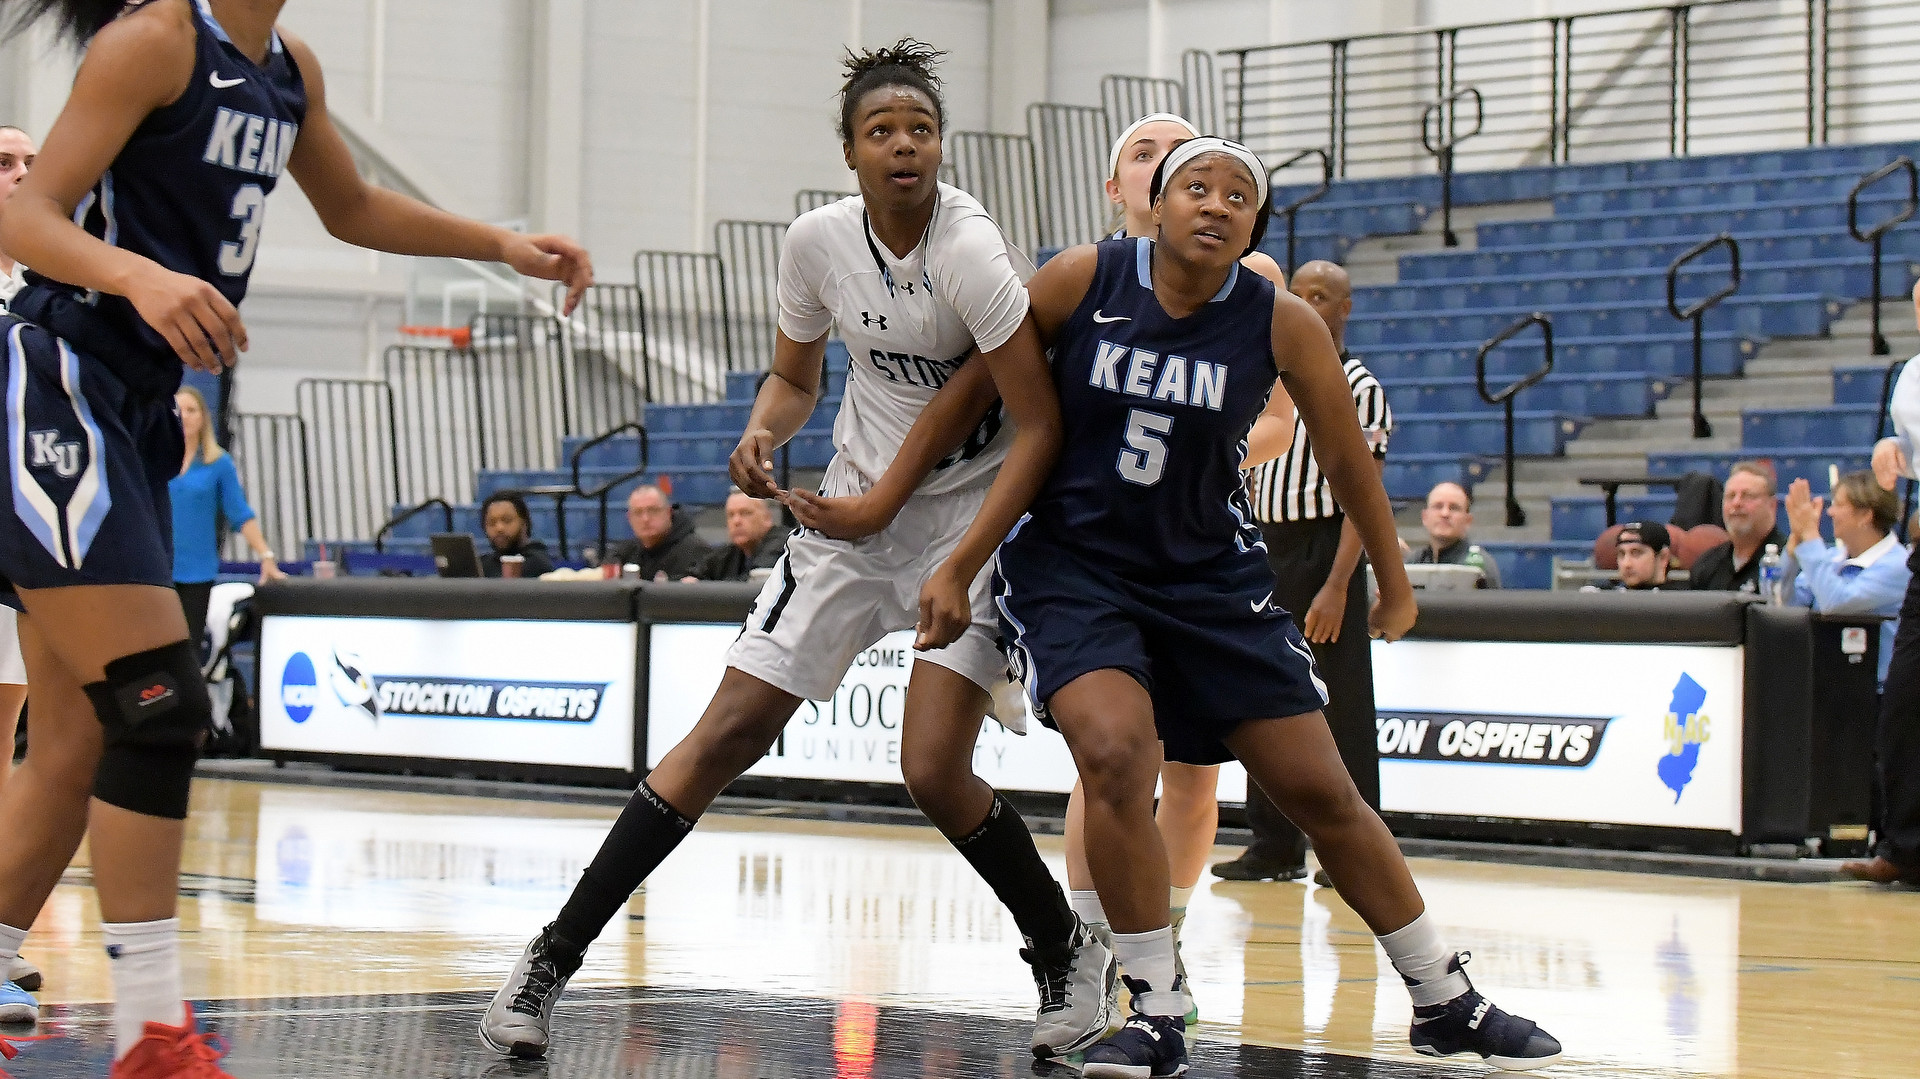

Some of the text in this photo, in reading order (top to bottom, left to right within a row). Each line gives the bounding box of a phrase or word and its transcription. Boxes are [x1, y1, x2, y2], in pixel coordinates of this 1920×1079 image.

[217, 183, 265, 277] 3
[1089, 340, 1228, 411] KEAN
[28, 428, 80, 478] KU
[1116, 407, 1174, 487] 5
[850, 649, 905, 668] COME
[378, 681, 598, 719] STOCKTON OSPREYS
[1438, 720, 1594, 762] OSPREYS
